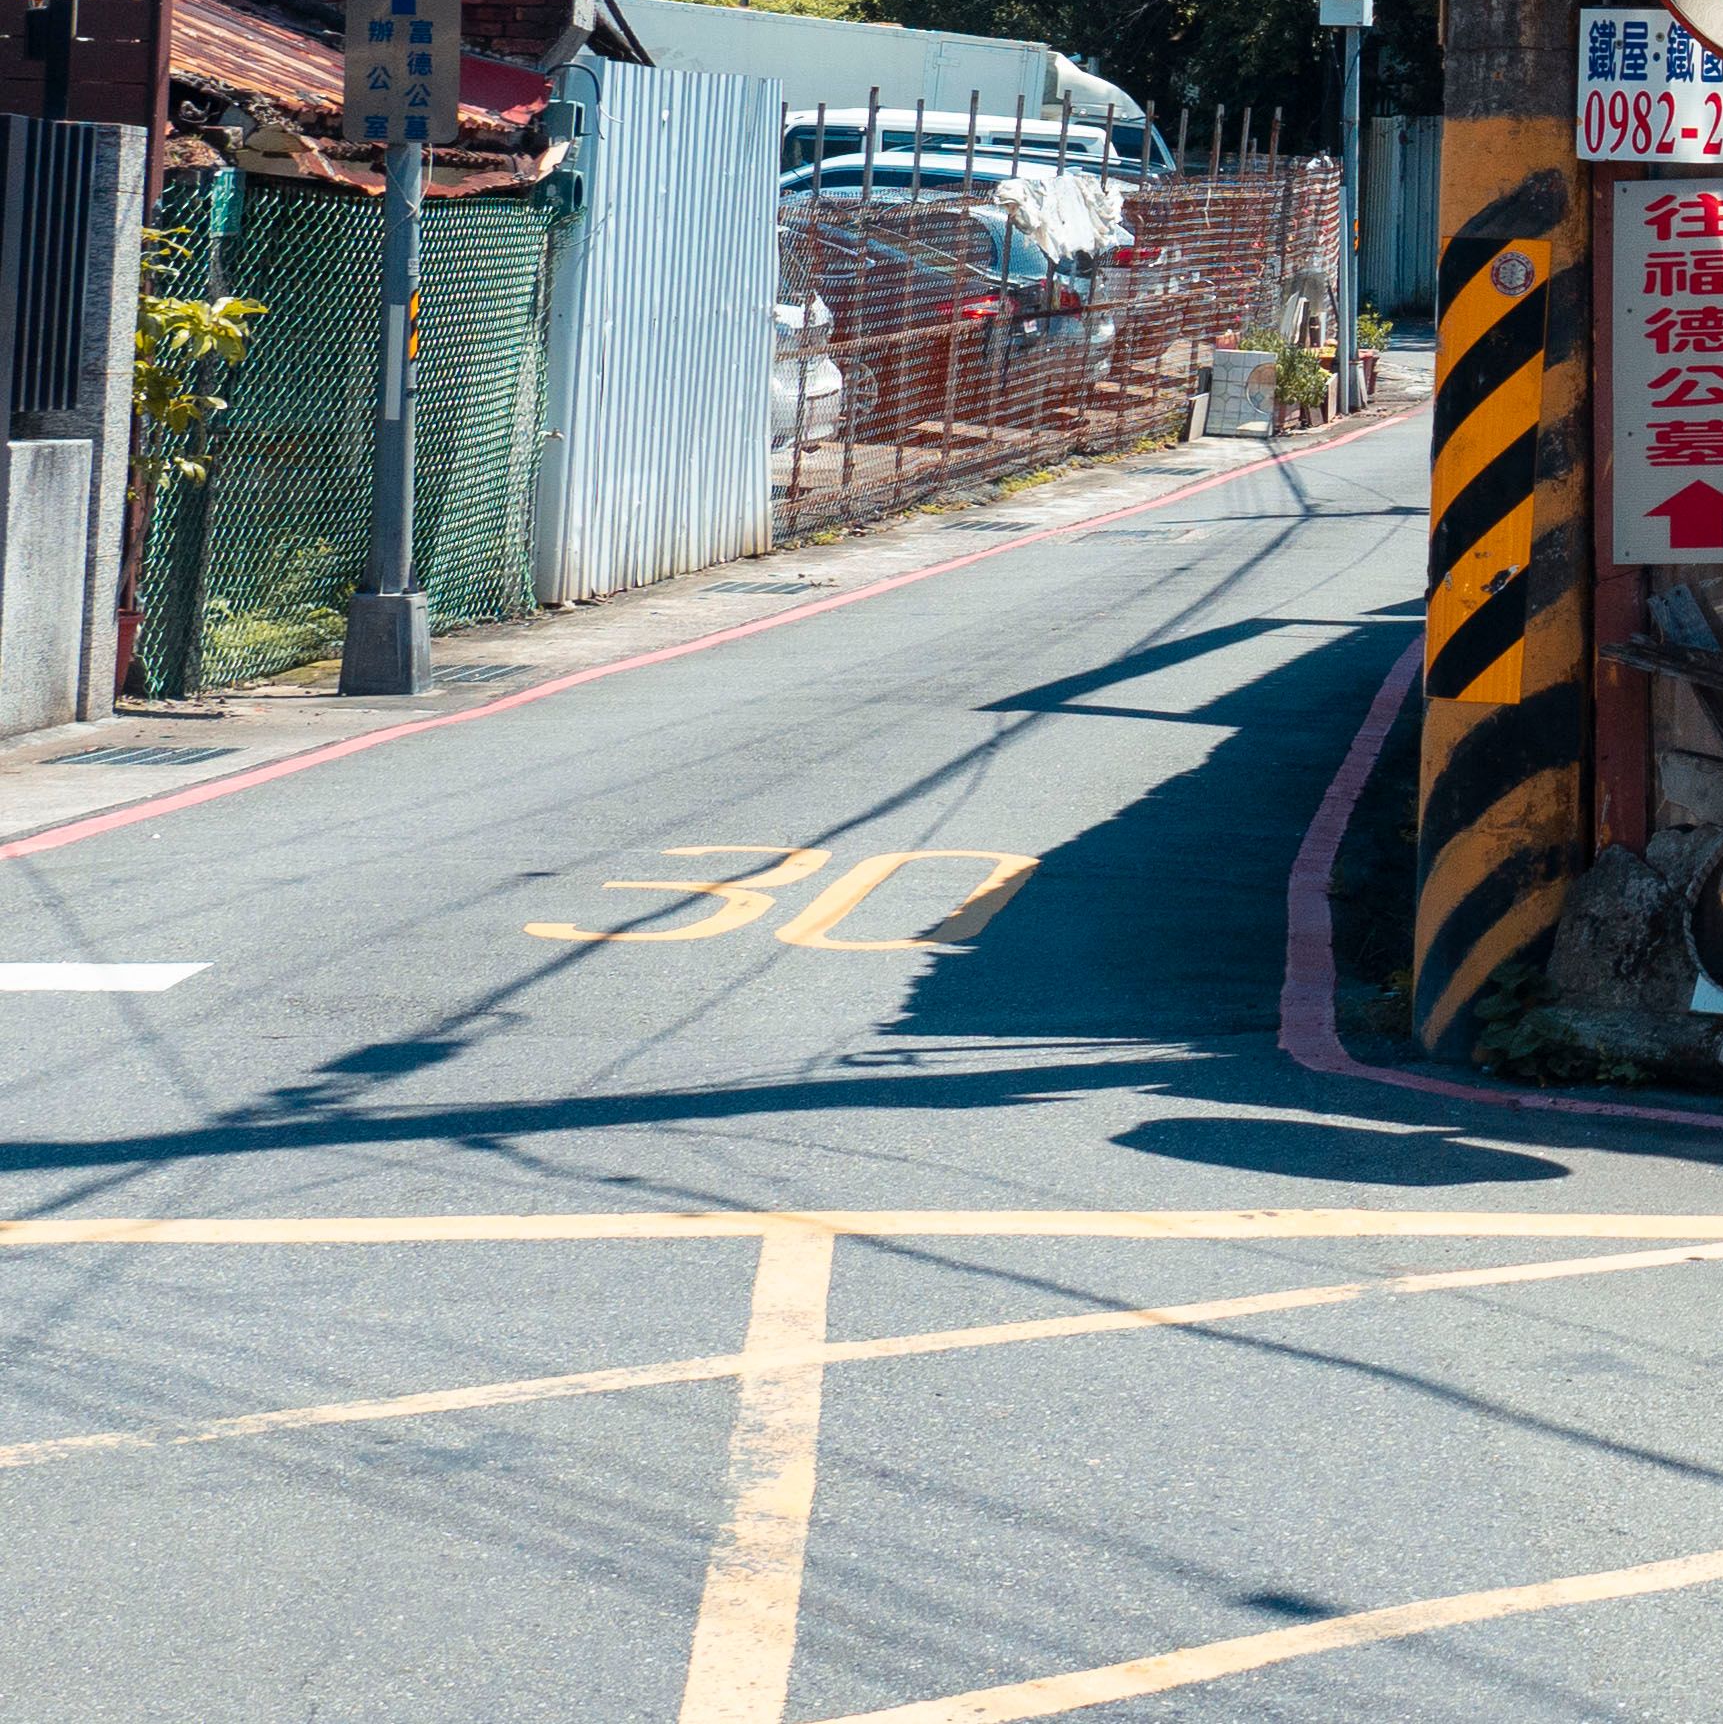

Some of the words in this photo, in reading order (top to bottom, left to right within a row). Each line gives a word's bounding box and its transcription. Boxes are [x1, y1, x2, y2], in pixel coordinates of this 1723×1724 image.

[364, 20, 394, 139] 辦公室
[404, 20, 433, 140] 富德公墓
[523, 845, 1042, 951] 30
